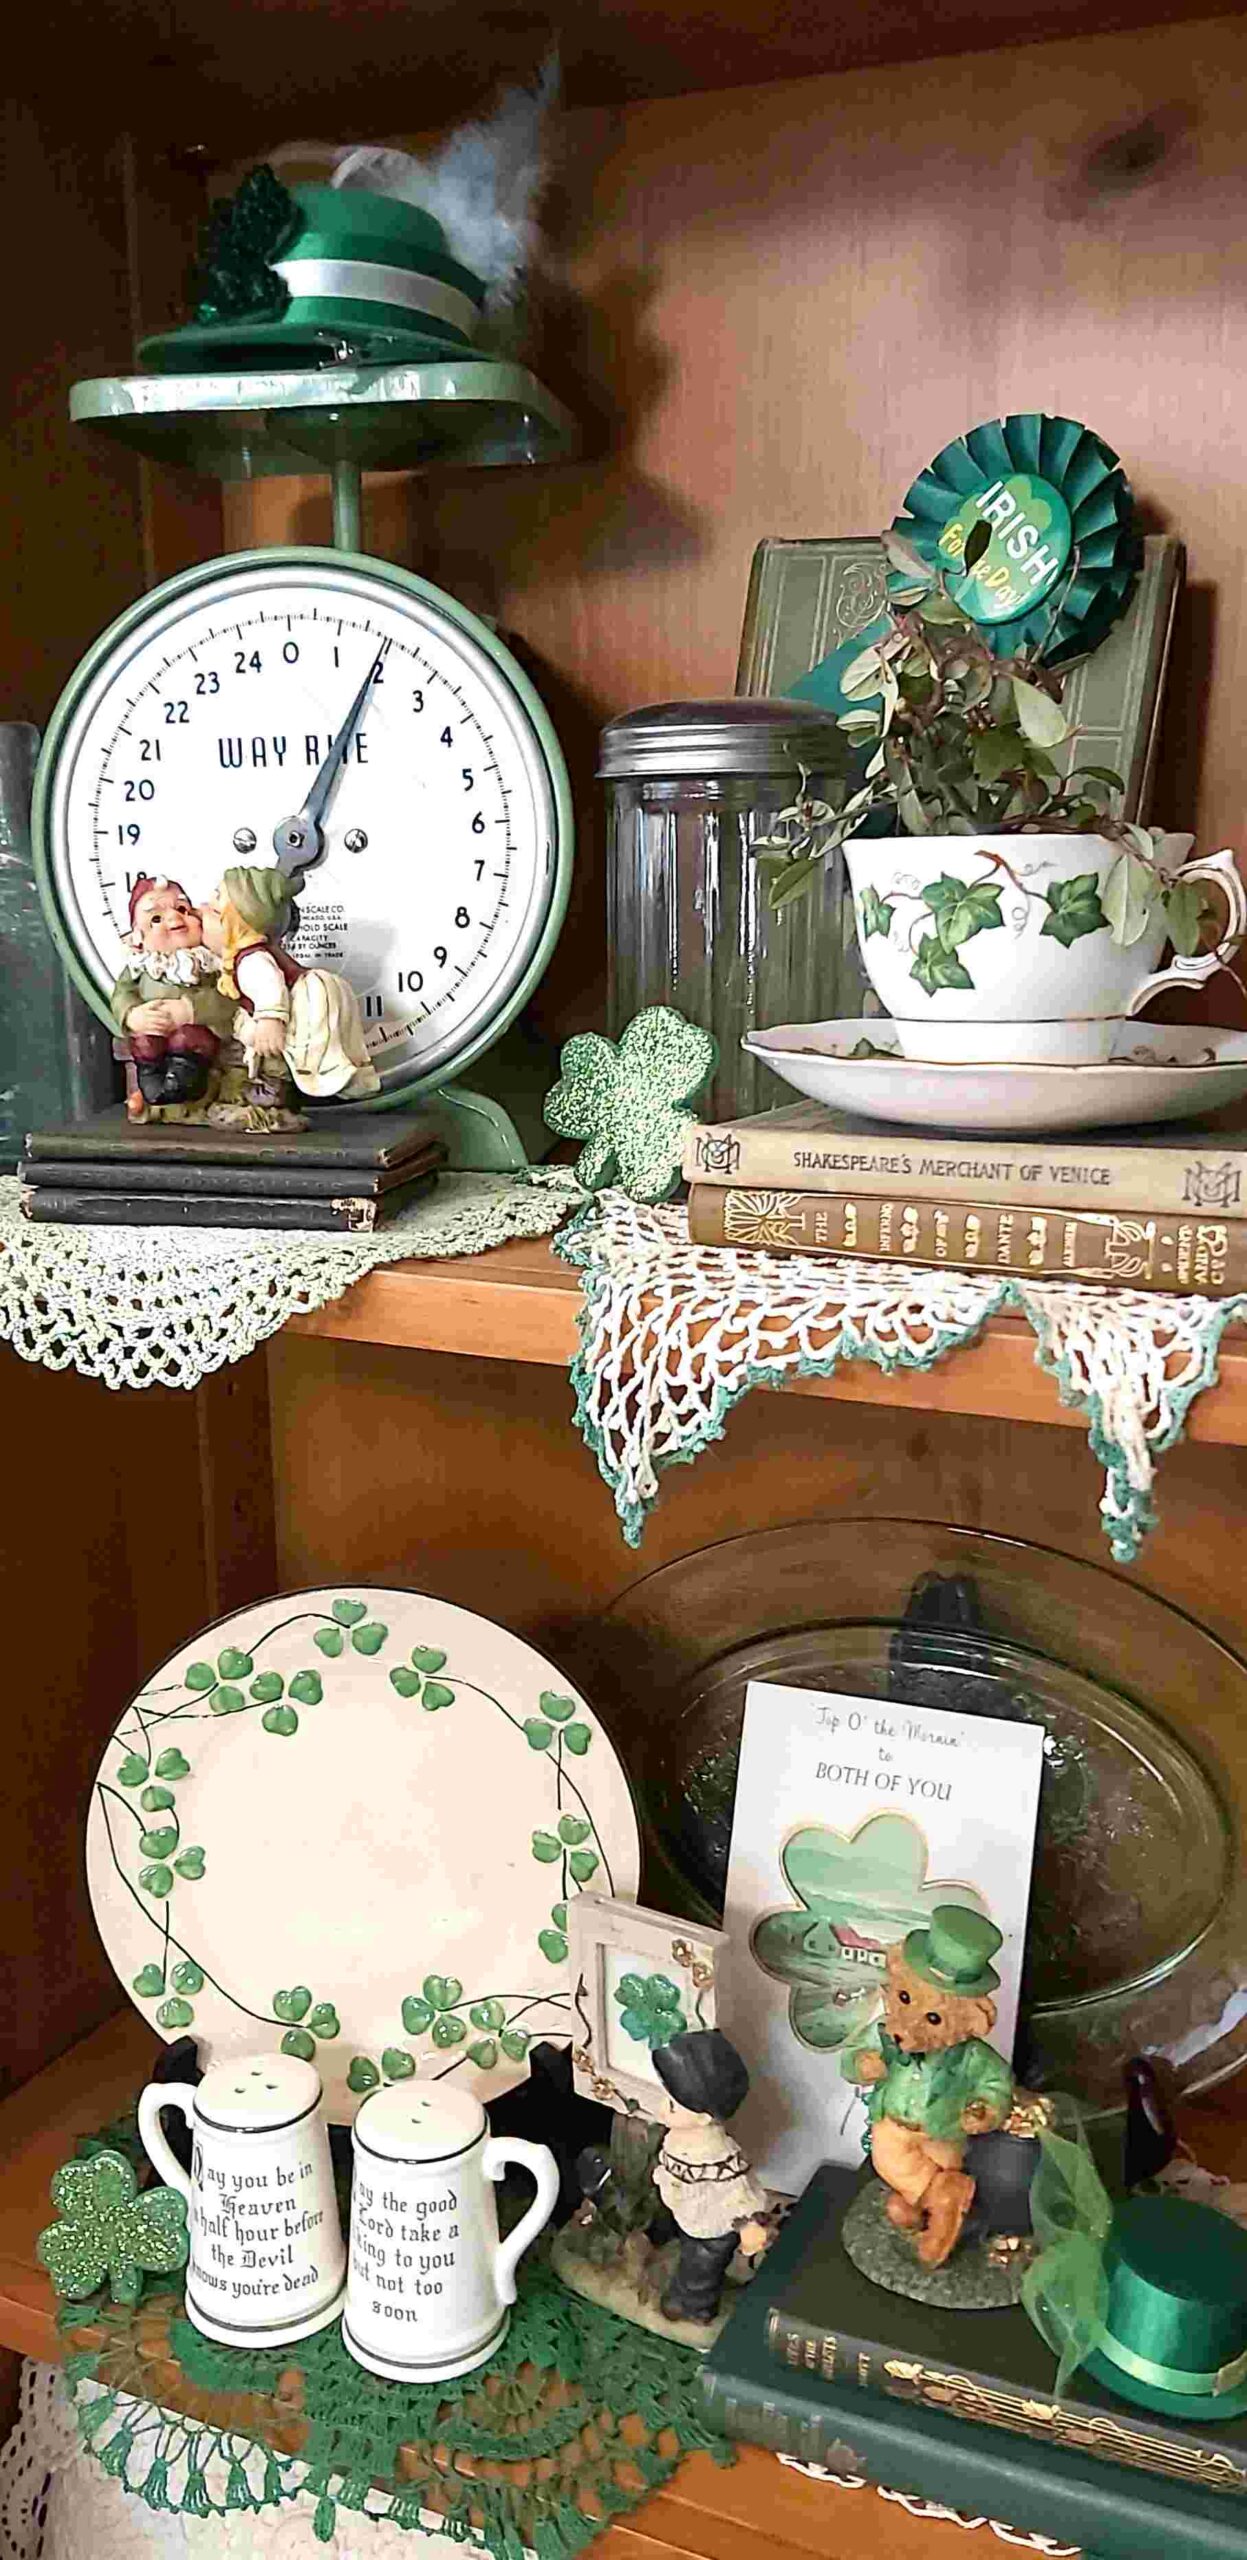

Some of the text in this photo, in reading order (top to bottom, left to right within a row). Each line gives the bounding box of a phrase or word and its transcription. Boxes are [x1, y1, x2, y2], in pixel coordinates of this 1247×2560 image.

[976, 481, 1058, 585] IRISH
[234, 651, 263, 673] 24
[283, 642, 299, 664] 0
[334, 646, 339, 668] 1
[195, 672, 221, 696] 23
[372, 661, 384, 684] 2
[164, 701, 190, 724] 22
[412, 690, 424, 713] 3
[440, 726, 453, 748] 4
[140, 739, 161, 762] 21
[218, 736, 287, 768] WAY
[124, 779, 155, 801] 20
[462, 768, 473, 791] 5
[472, 811, 485, 834] 6
[118, 824, 140, 846] 19
[474, 860, 485, 882] 7
[306, 905, 329, 914] SCALE
[455, 907, 470, 928] 8
[323, 923, 348, 931] SCALE
[434, 946, 447, 968] 9
[398, 971, 423, 992] 10
[366, 996, 383, 1017] 11
[793, 1152, 1111, 1186] SHAKESPEARE'S MERCHANT OF VENICE
[814, 1212, 828, 1243] THE
[998, 1214, 1013, 1264] DANTE
[874, 1719, 895, 1737] the
[878, 1747, 893, 1761] to
[815, 1762, 952, 1801] BOTH OF YOU
[232, 2175, 268, 2192] you
[276, 2166, 294, 2186] be
[299, 2161, 313, 2179] in
[219, 2193, 296, 2219] Heaven
[382, 2191, 408, 2213] the
[416, 2189, 458, 2221] good
[200, 2206, 231, 2237] half
[235, 2220, 279, 2246] hour
[359, 2203, 459, 2242] Lord take a
[211, 2243, 294, 2269] the Devil
[395, 2248, 413, 2267] to
[419, 2251, 455, 2275] you
[283, 2265, 319, 2291] dead
[376, 2274, 404, 2293] not
[414, 2279, 443, 2296] too
[372, 2300, 418, 2322] soon
